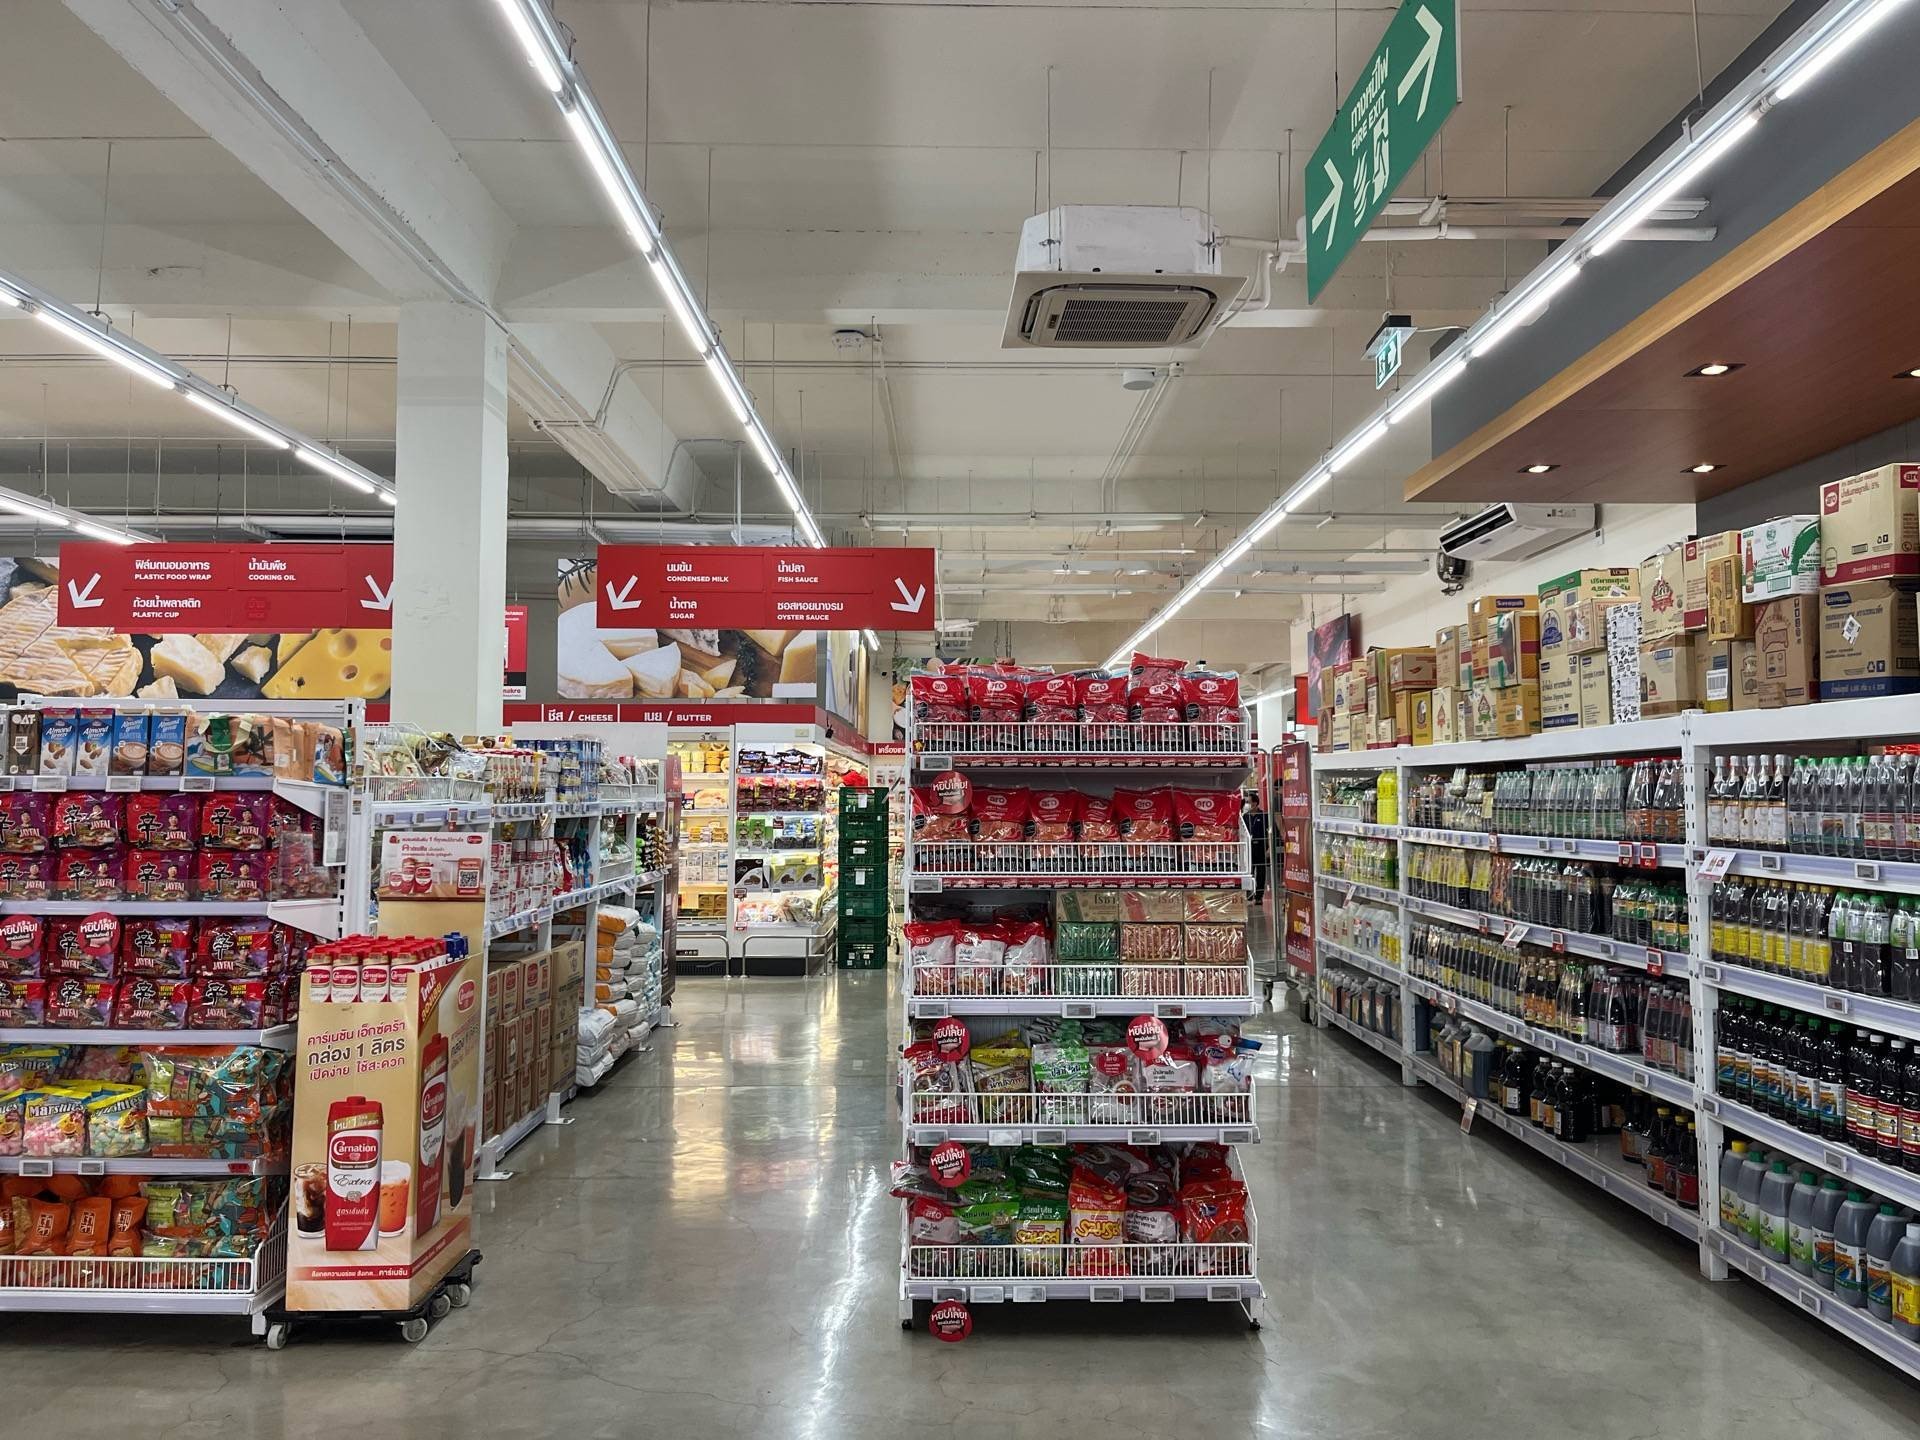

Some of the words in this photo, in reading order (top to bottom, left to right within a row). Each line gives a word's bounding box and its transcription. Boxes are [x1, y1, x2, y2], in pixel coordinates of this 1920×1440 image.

[1351, 47, 1389, 133] ทางหนีไฟ
[1352, 118, 1367, 156] FIRE
[1369, 89, 1385, 129] EXIT
[135, 559, 210, 570] ฟิล์มถนอมอาหาร
[249, 558, 286, 571] น้ำมันพืช
[667, 561, 692, 572] นมข้น
[777, 560, 805, 573] น้ำปลา
[133, 595, 201, 608] ถ้วยน้ำพลาสติก
[669, 596, 697, 609] น้ำตาล
[777, 602, 844, 611] ซอสหอยนางรม
[578, 714, 613, 722] CHEESE
[644, 712, 662, 721] เนย
[676, 714, 712, 722] BUTTER
[45, 726, 73, 736] Almond
[82, 726, 109, 736] Almond
[0, 860, 22, 892] 辛
[67, 862, 93, 891] 辛
[137, 862, 161, 895] 辛
[209, 861, 234, 893] 辛
[308, 1044, 350, 1065] กล่อง
[356, 1044, 364, 1057] 1
[371, 1038, 405, 1055] ลิตร
[310, 1065, 350, 1080] เปิดง่าย
[357, 1056, 405, 1073] ใช้สะดวก
[29, 1101, 84, 1118] Marshies
[334, 1140, 376, 1155] Carnation
[334, 1174, 372, 1186] Extra
